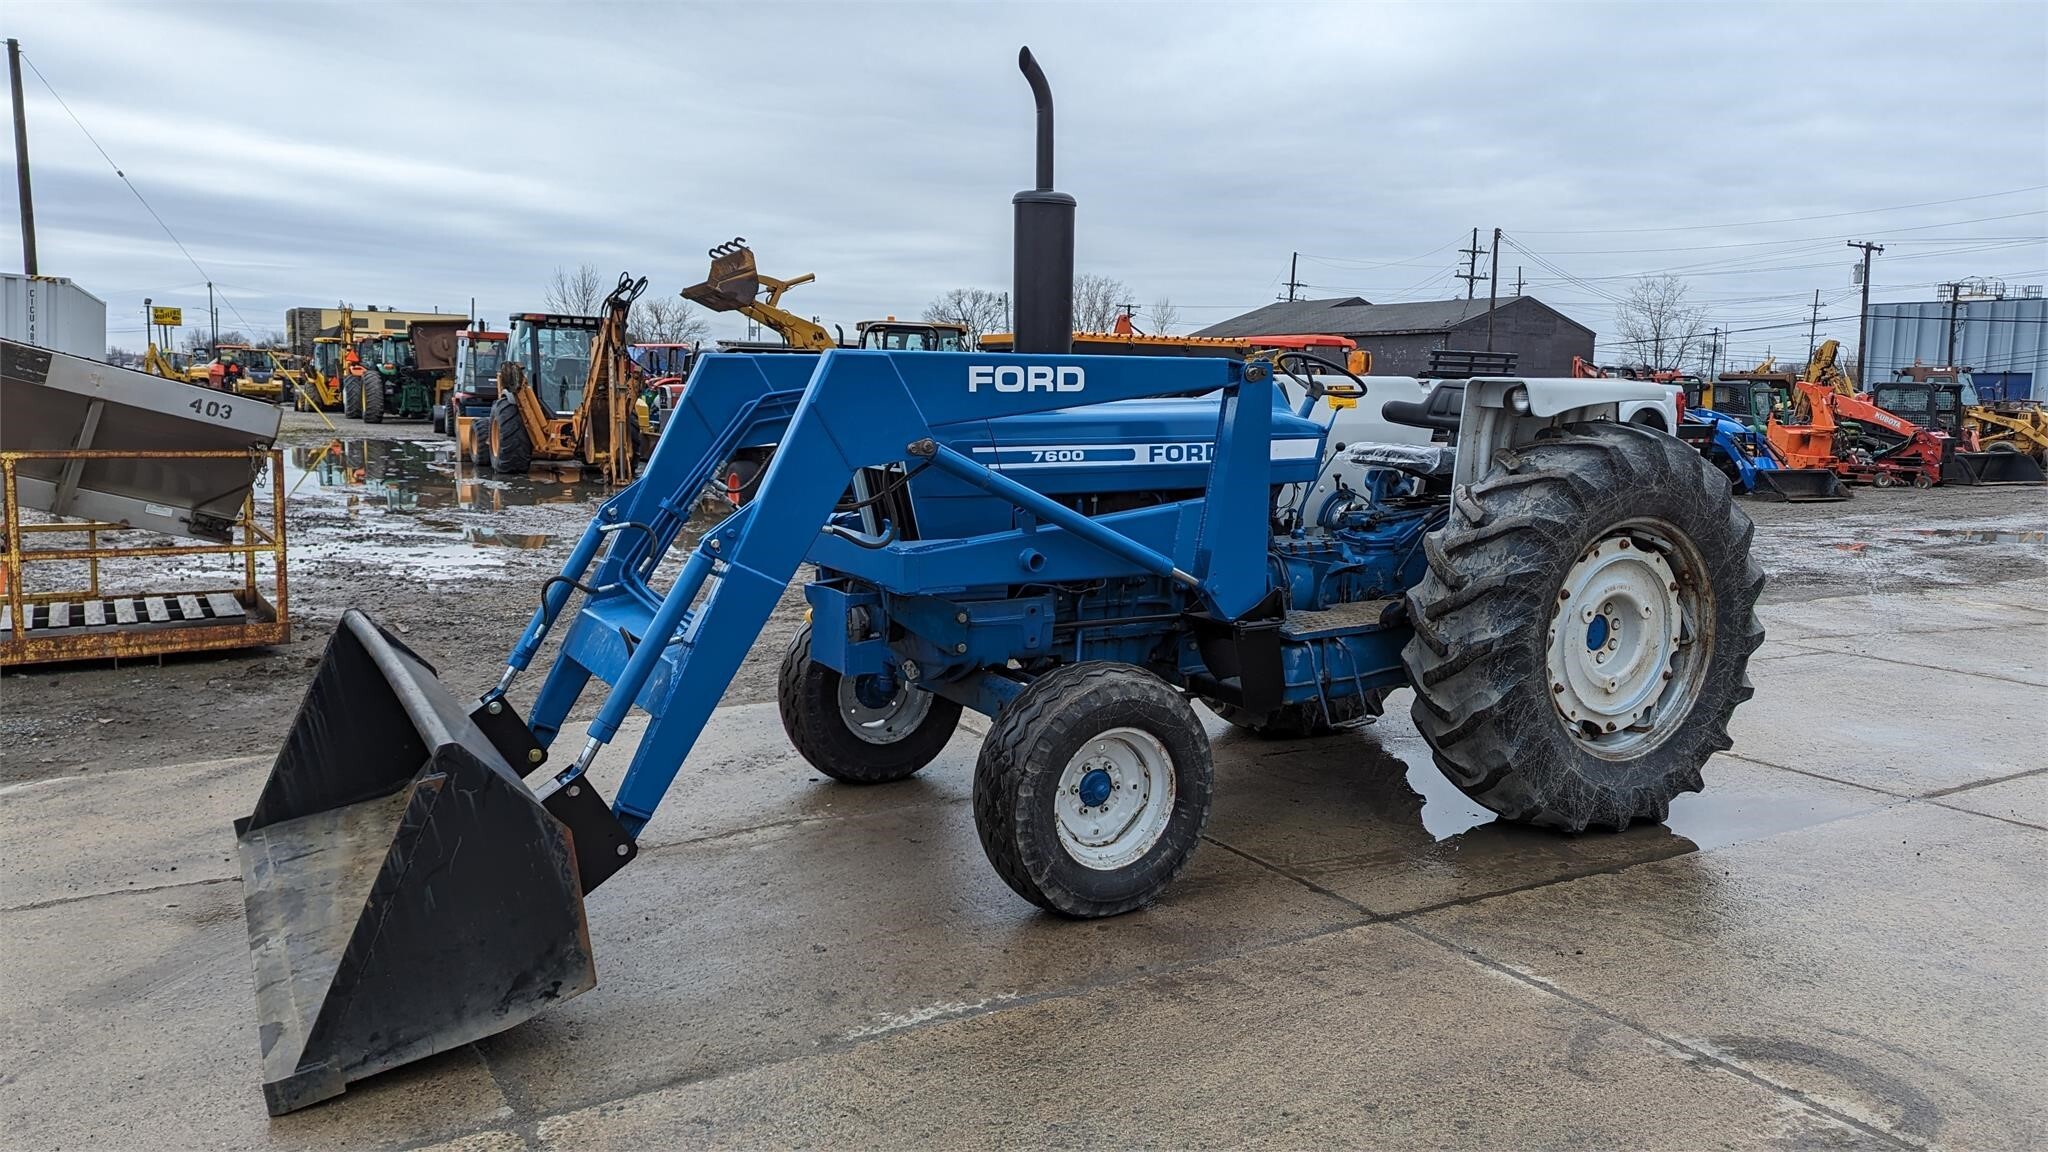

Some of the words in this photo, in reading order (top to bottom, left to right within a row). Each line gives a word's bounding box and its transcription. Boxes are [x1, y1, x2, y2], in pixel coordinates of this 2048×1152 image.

[968, 365, 1085, 393] FORD
[189, 398, 233, 420] 403
[1874, 411, 1901, 428] KUBOTA
[1031, 450, 1085, 462] 7600
